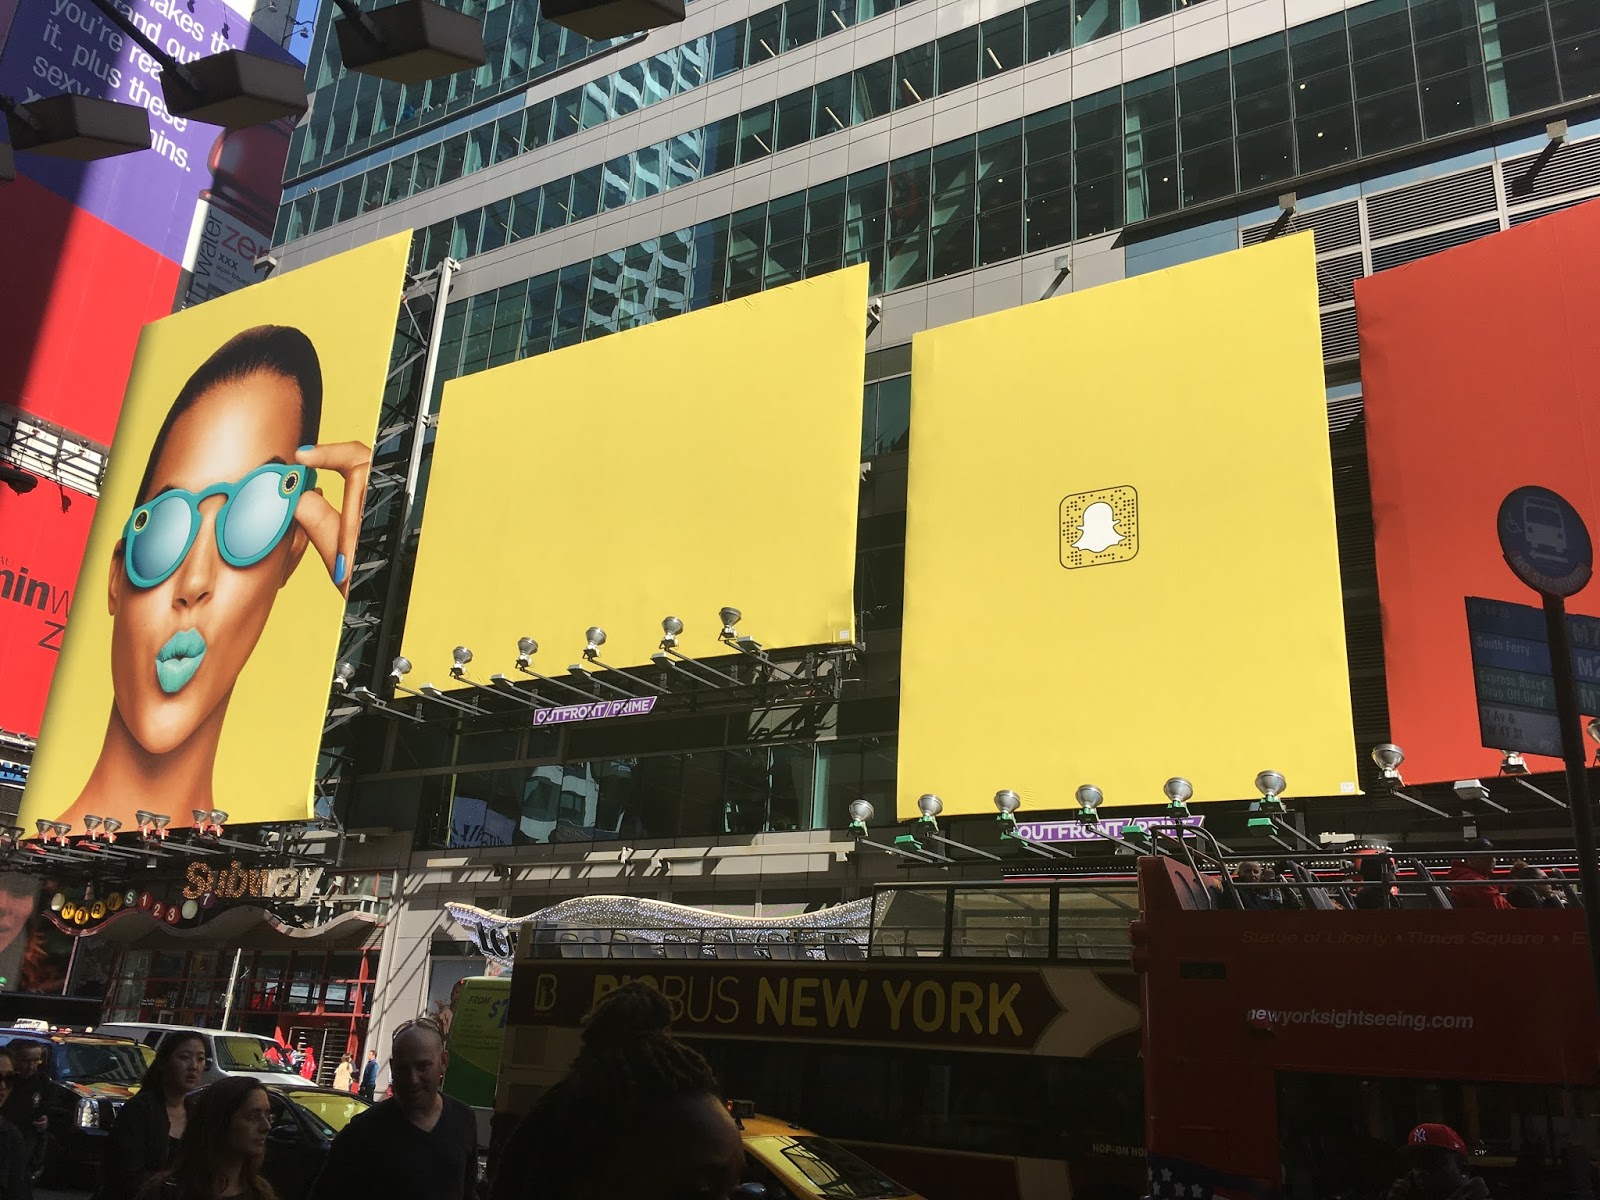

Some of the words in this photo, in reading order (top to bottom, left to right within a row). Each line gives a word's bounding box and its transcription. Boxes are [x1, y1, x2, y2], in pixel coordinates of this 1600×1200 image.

[50, 0, 122, 52] you're
[210, 31, 236, 53] th
[43, 18, 62, 51] it.
[72, 44, 121, 88] plus
[129, 76, 187, 132] these
[1477, 636, 1503, 651] South
[1506, 641, 1530, 656] Ferry
[1479, 670, 1517, 687] Express
[1481, 685, 1504, 700] Drop
[1524, 691, 1545, 708] Only
[182, 861, 324, 907] Subway
[1303, 931, 1321, 944] of
[1328, 931, 1388, 948] Liberty
[1407, 932, 1466, 945] Times
[1472, 931, 1545, 949] Square
[468, 996, 491, 1006] FROM
[756, 976, 868, 1028] NEW
[882, 980, 1023, 1036] YORK
[1247, 1009, 1474, 1031] newyorksightseeing.com
[1092, 1144, 1129, 1156] HOP-ON
